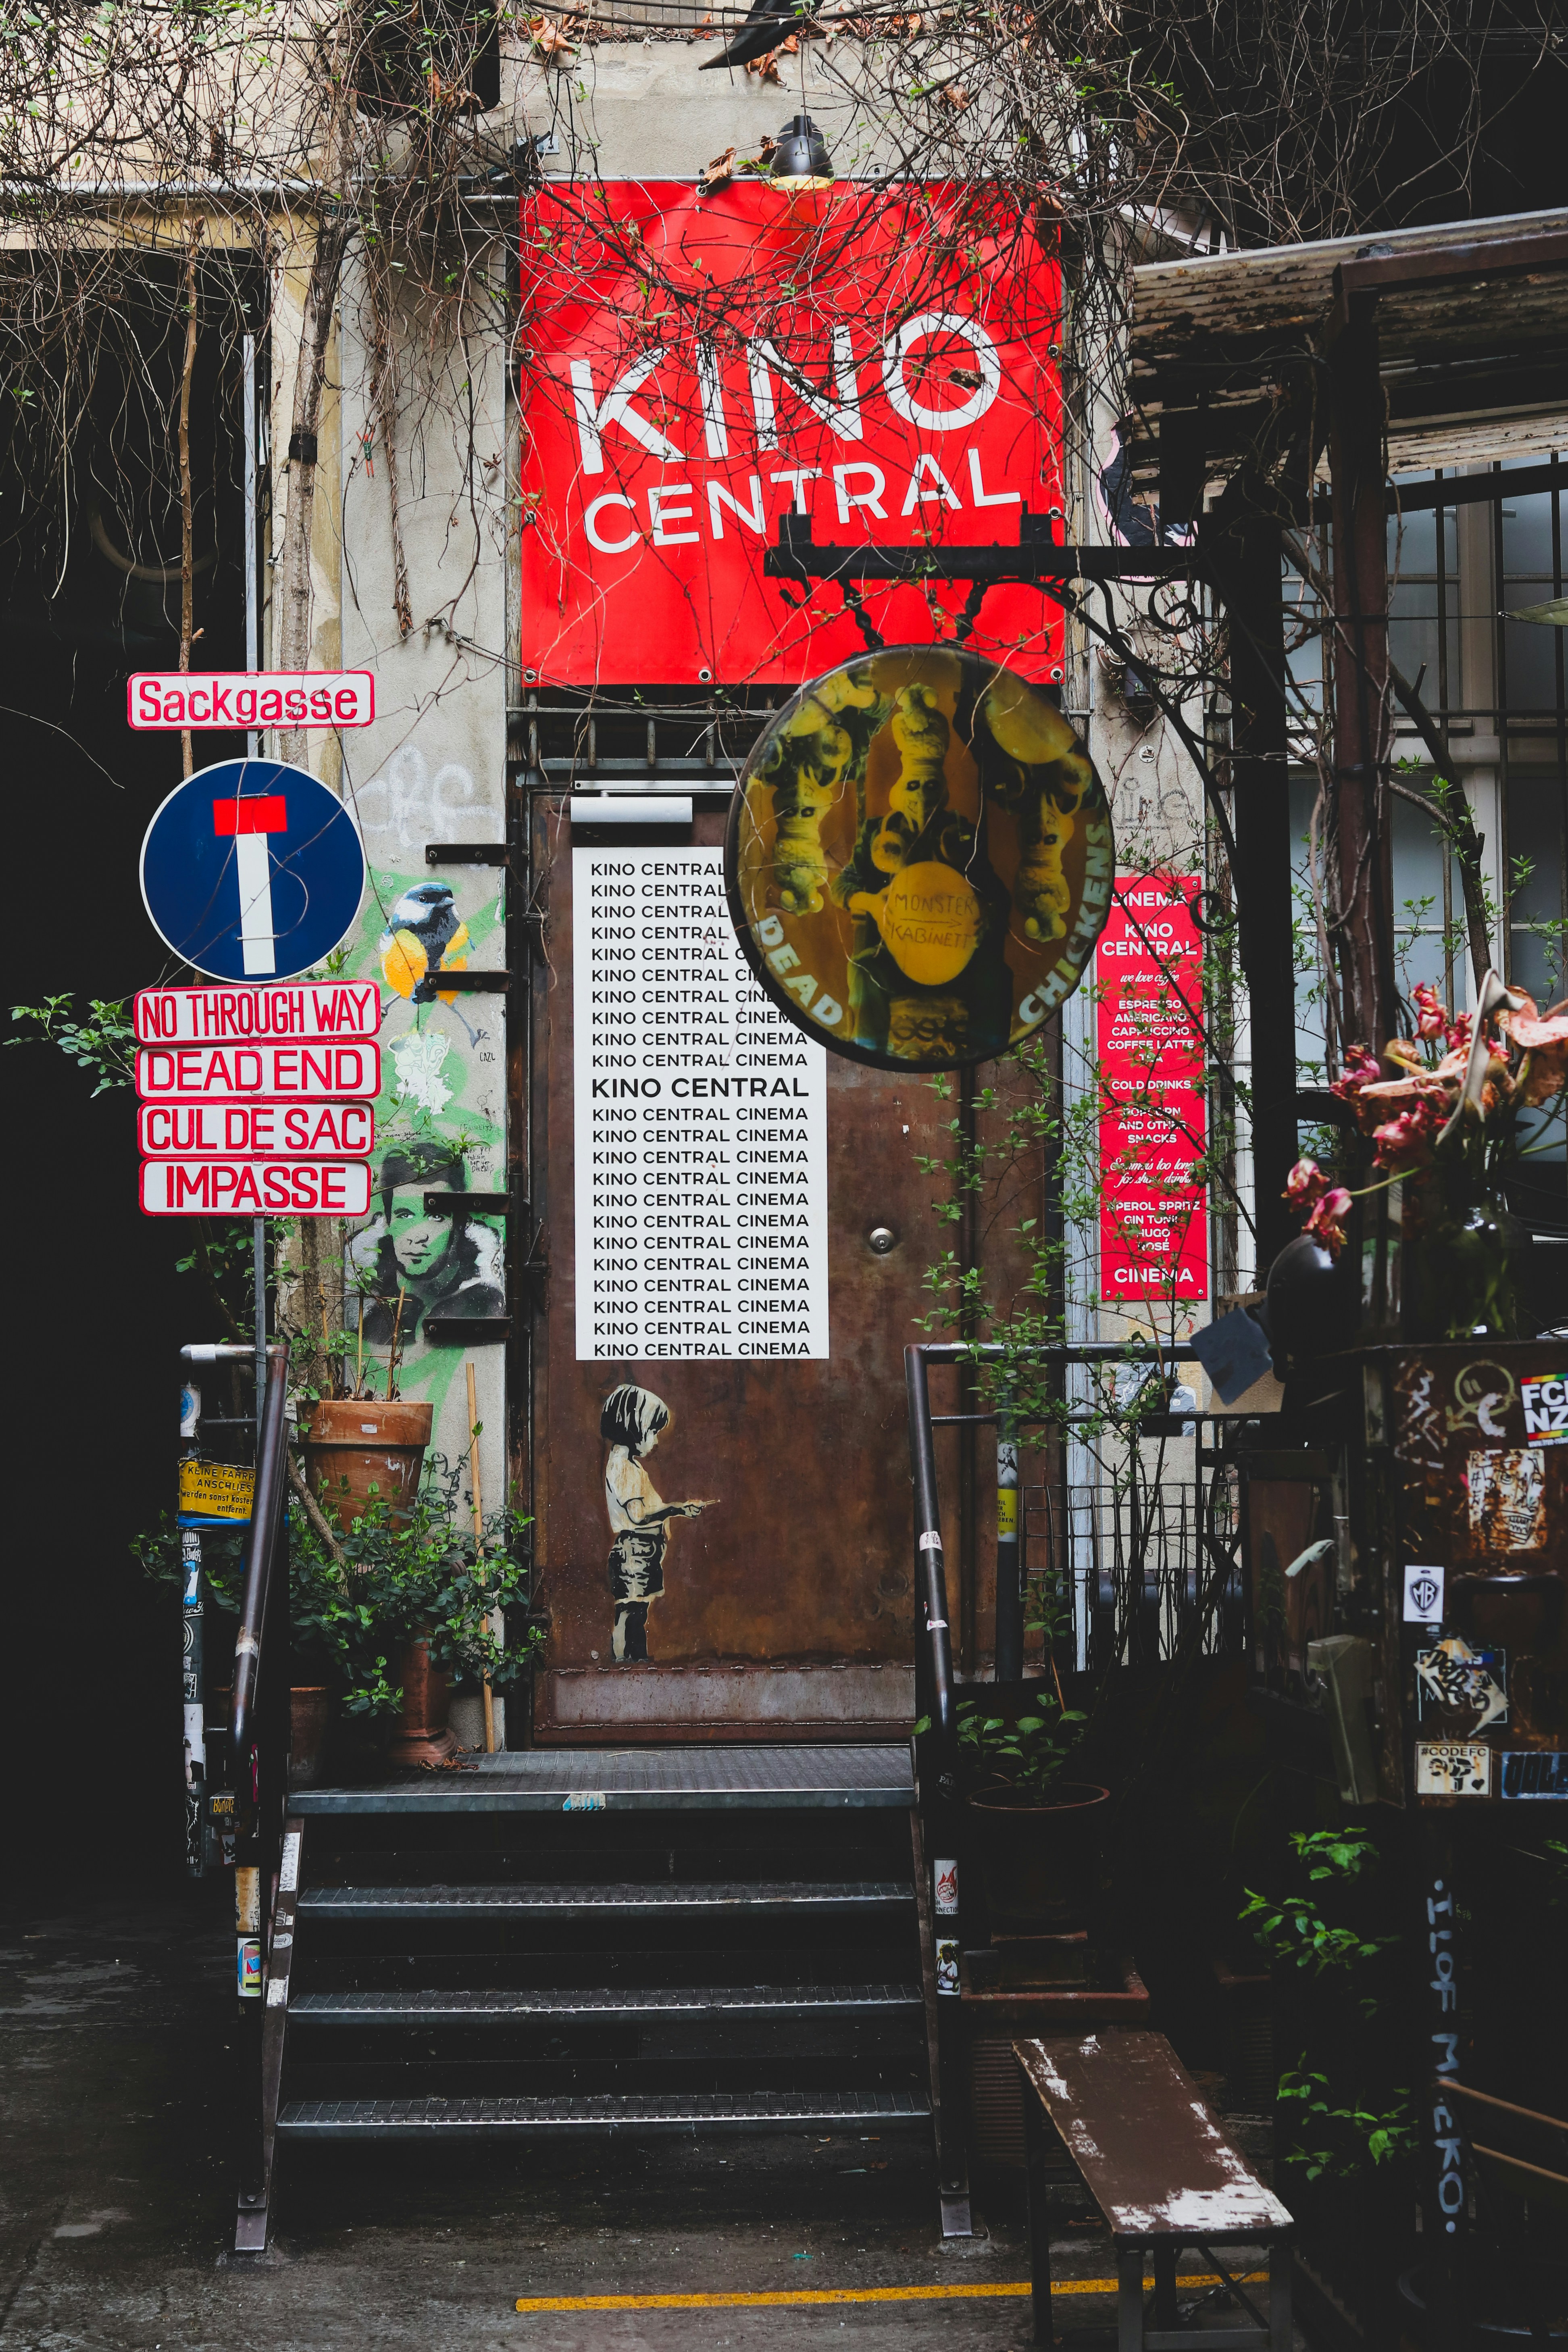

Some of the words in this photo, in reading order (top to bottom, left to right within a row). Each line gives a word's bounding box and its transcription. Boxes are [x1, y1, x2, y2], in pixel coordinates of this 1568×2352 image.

[570, 312, 1000, 475] KINO
[584, 448, 1020, 553] CENTRAL
[140, 681, 357, 725] Sackgasse
[592, 864, 635, 875] KINO
[641, 864, 724, 875] CENTRAL
[592, 885, 635, 896] KINO
[642, 885, 726, 896] CENTRAL
[895, 894, 974, 916] MONSTER
[592, 906, 635, 918] KINO
[642, 906, 728, 917] CENTRAL
[1019, 823, 1112, 1025] CHICKENS
[592, 927, 635, 939] KINO
[642, 927, 729, 940] CENTRAL
[592, 948, 635, 960] KINO
[642, 948, 728, 960] CENTRAL
[1102, 940, 1197, 956] CENTRAL
[593, 970, 635, 981] KINO
[642, 969, 729, 981] CENTRAL
[756, 915, 843, 1025] DEAD
[1120, 974, 1134, 983] we
[1135, 970, 1153, 983] love
[593, 991, 635, 1003] KINO
[643, 991, 729, 1002] CENTRAL
[736, 990, 773, 1002] CIN
[1118, 999, 1181, 1009] ESPRESO
[143, 996, 177, 1038] NO
[186, 991, 304, 1036] THROUGH
[312, 988, 371, 1031] WAY
[593, 1012, 635, 1024] KINO
[643, 1012, 729, 1024] CENTRAL
[736, 1011, 793, 1023] CINEM
[593, 1033, 636, 1045] KINO
[643, 1033, 729, 1045] CENTRAL
[736, 1033, 807, 1044] CINEMA
[1107, 1040, 1153, 1050] COFFEE
[1157, 1040, 1195, 1049] LATTE
[593, 1055, 636, 1067] KINO
[643, 1054, 729, 1067] CENTRAL
[736, 1054, 807, 1066] CINEMA
[148, 1050, 262, 1091] DEAD
[274, 1049, 363, 1090] END
[593, 1079, 661, 1098] KINO
[672, 1078, 808, 1097] CENTRAL
[1111, 1080, 1144, 1090] COLD
[1147, 1080, 1191, 1090] DRINKS
[593, 1109, 636, 1121] KINO
[643, 1108, 729, 1121] CENTRAL
[737, 1108, 808, 1120] CINEMA
[147, 1108, 217, 1150] CUL
[226, 1108, 274, 1149] DE
[285, 1108, 366, 1150] SAC
[1118, 1121, 1144, 1130] AND
[593, 1130, 636, 1142] KINO
[643, 1130, 730, 1142] CENTRAL
[737, 1129, 808, 1141] CINEMA
[1128, 1134, 1177, 1144] SNACKS
[593, 1152, 636, 1164] KINO
[643, 1151, 730, 1163] CENTRAL
[737, 1151, 808, 1162] CINEMA
[1156, 1158, 1172, 1170] too
[594, 1173, 637, 1185] KINO
[643, 1173, 730, 1185] CENTRAL
[737, 1172, 808, 1184] CINEMA
[166, 1166, 346, 1208] IMPASSE
[594, 1194, 637, 1206] KINO
[644, 1194, 730, 1206] CENTRAL
[737, 1194, 808, 1205] CINEMA
[594, 1216, 637, 1228] KINO
[644, 1215, 730, 1227] CENTRAL
[737, 1215, 808, 1227] CINEMA
[1124, 1215, 1144, 1225] GIN
[594, 1237, 637, 1249] KINO
[644, 1237, 731, 1249] CENTRAL
[737, 1236, 809, 1248] CINEMA
[594, 1258, 637, 1271] KINO
[644, 1258, 731, 1270] CENTRAL
[738, 1257, 809, 1269] CINEMA
[1114, 1268, 1194, 1283] CINEMA
[594, 1280, 637, 1292] KINO
[644, 1279, 731, 1292] CENTRAL
[738, 1279, 809, 1291] CINEMA
[595, 1301, 637, 1313] KINO
[645, 1301, 731, 1313] CENTRAL
[738, 1300, 809, 1312] CINEMA
[595, 1323, 638, 1335] KINO
[645, 1322, 731, 1334] CENTRAL
[738, 1321, 810, 1333] CINEMA
[595, 1344, 638, 1356] KINO
[645, 1344, 731, 1356] CENTRAL
[739, 1343, 810, 1355] CINEMA
[188, 1466, 218, 1477] KEINE
[223, 1469, 255, 1481] FAHRR
[182, 1490, 207, 1500] werden
[209, 1492, 229, 1502] sonst
[217, 1504, 248, 1515] entfernt.
[1421, 1746, 1487, 1756] #CODEFC
